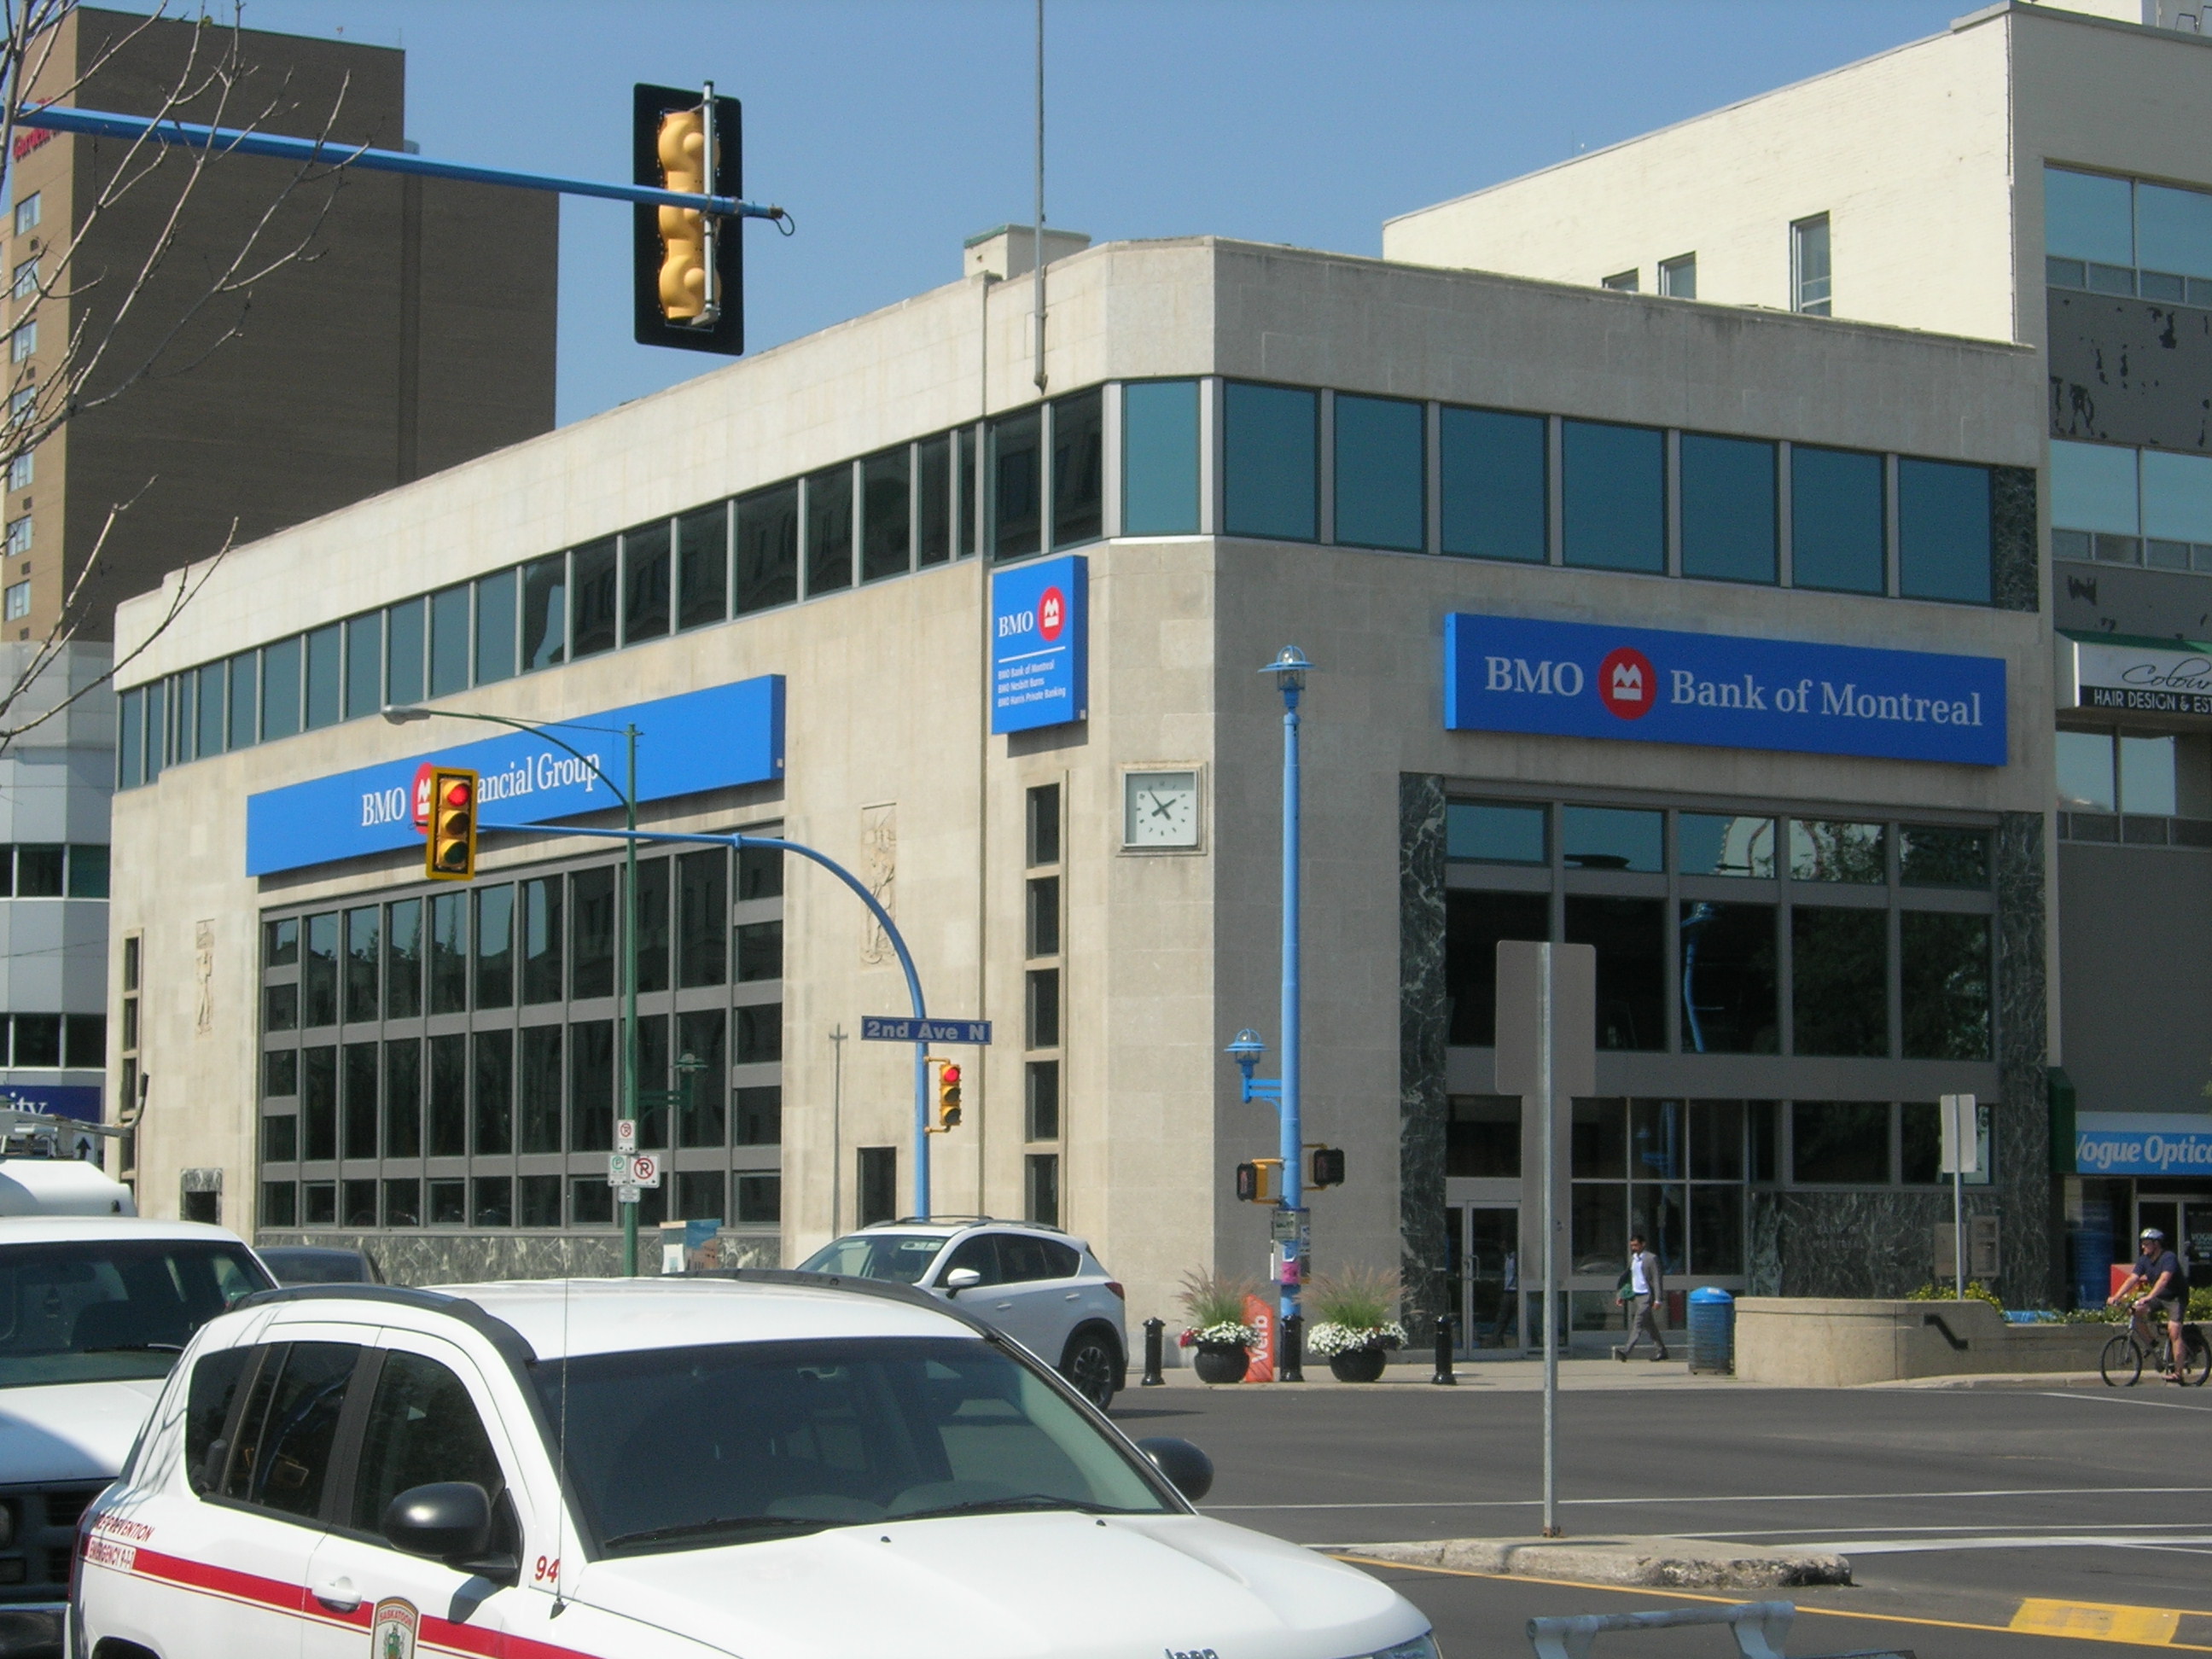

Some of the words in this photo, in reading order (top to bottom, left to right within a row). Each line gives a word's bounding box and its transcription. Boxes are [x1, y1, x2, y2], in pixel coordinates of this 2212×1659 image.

[998, 611, 1033, 637] BMO
[1484, 656, 1585, 696] BMO
[1670, 670, 1768, 710] Bank
[1775, 678, 1813, 713] of
[1820, 681, 1983, 726] Montreal
[2094, 689, 2124, 707] HAIR
[2128, 693, 2176, 710] DESIGN
[362, 787, 405, 826] BMO
[477, 756, 533, 804] ancial
[537, 753, 600, 792] Group
[866, 1021, 909, 1039] 2nd
[917, 1022, 958, 1039] Ave
[969, 1025, 984, 1041] N
[535, 1555, 560, 1583] 94
